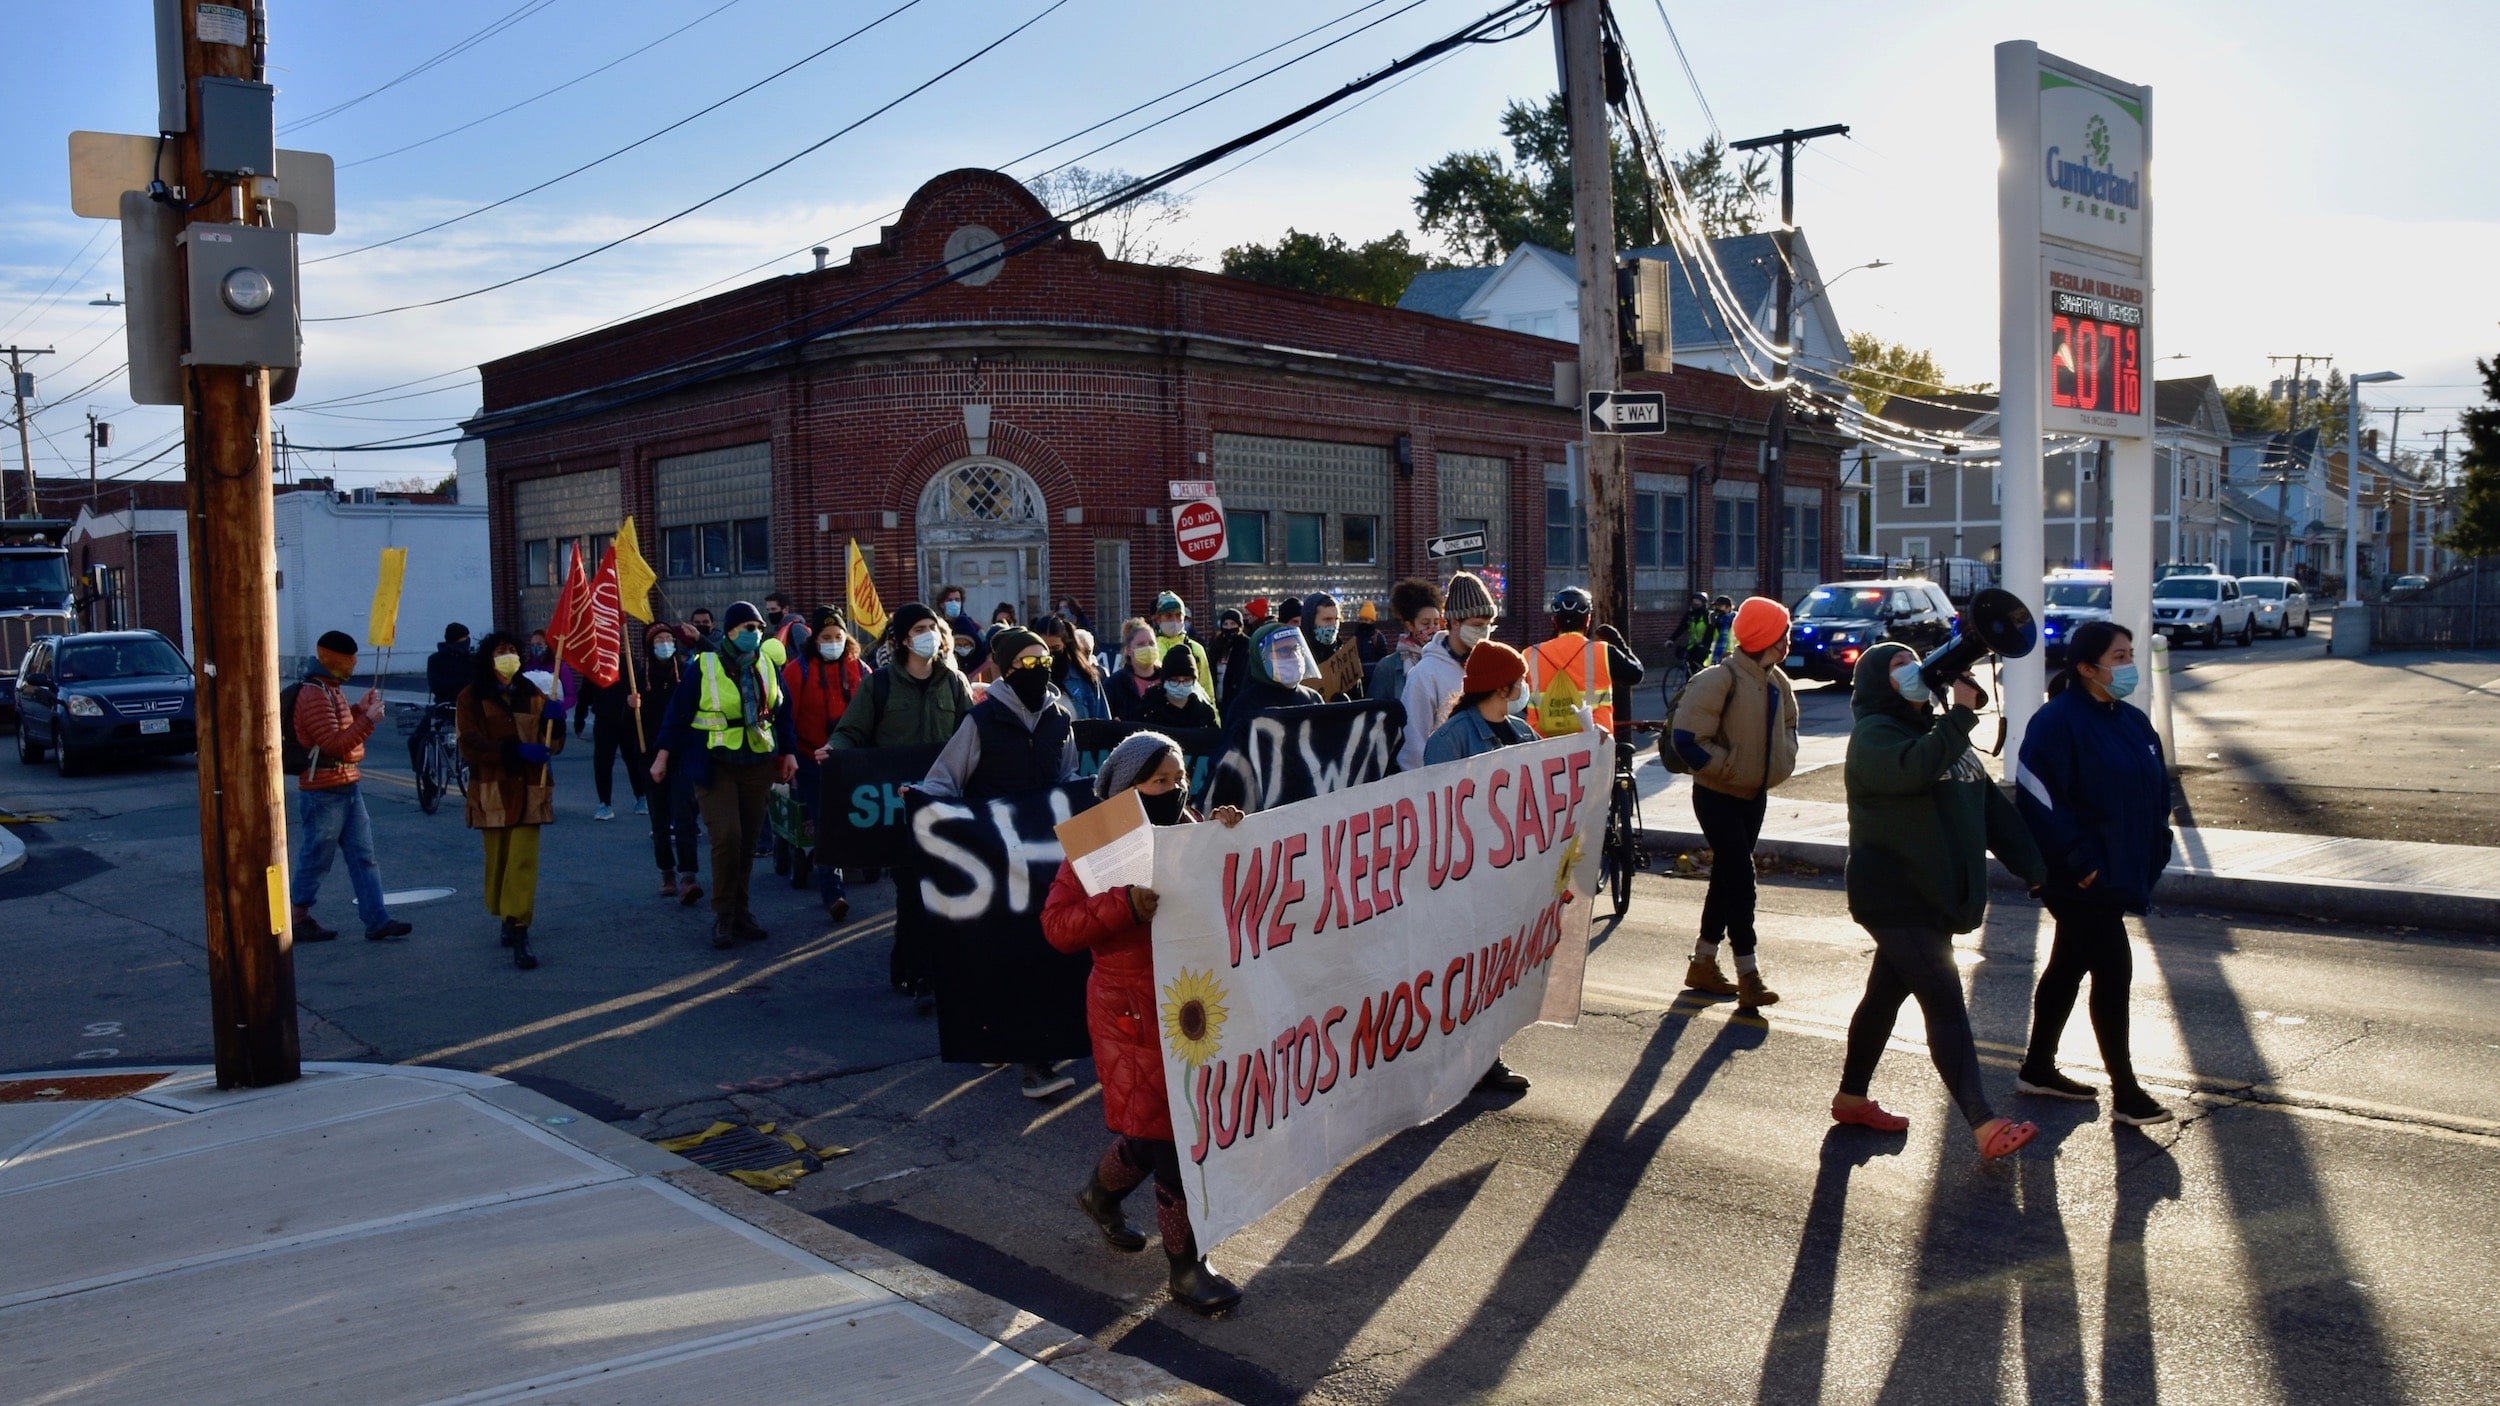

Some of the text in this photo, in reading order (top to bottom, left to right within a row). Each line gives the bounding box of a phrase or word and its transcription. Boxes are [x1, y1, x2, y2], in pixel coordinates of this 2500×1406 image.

[200, 6, 245, 18] INFORMATION
[2046, 145, 2139, 210] Cumberland
[2062, 195, 2127, 224] FARMS
[2050, 271, 2143, 304] REGULAR UNLEADED
[2059, 293, 2141, 324] SMARTPAY MEMBER
[1628, 405, 1654, 421] WAY
[2080, 413, 2117, 428] TAX INCLUDED
[1180, 483, 1208, 497] CENTRAL
[1181, 511, 1215, 527] DO NOT
[1188, 538, 1216, 552] ENTER
[1444, 536, 1480, 550] ONE WAY
[1340, 661, 1359, 691] ALL
[848, 782, 907, 828] SH
[912, 788, 1072, 920] SH
[1221, 832, 1307, 968] WE
[1313, 797, 1420, 935] KEEP
[1426, 778, 1475, 891] US
[1486, 750, 1592, 869] SAFE
[1190, 889, 1574, 1165] JUNTOS NOS CUIDAMOS
